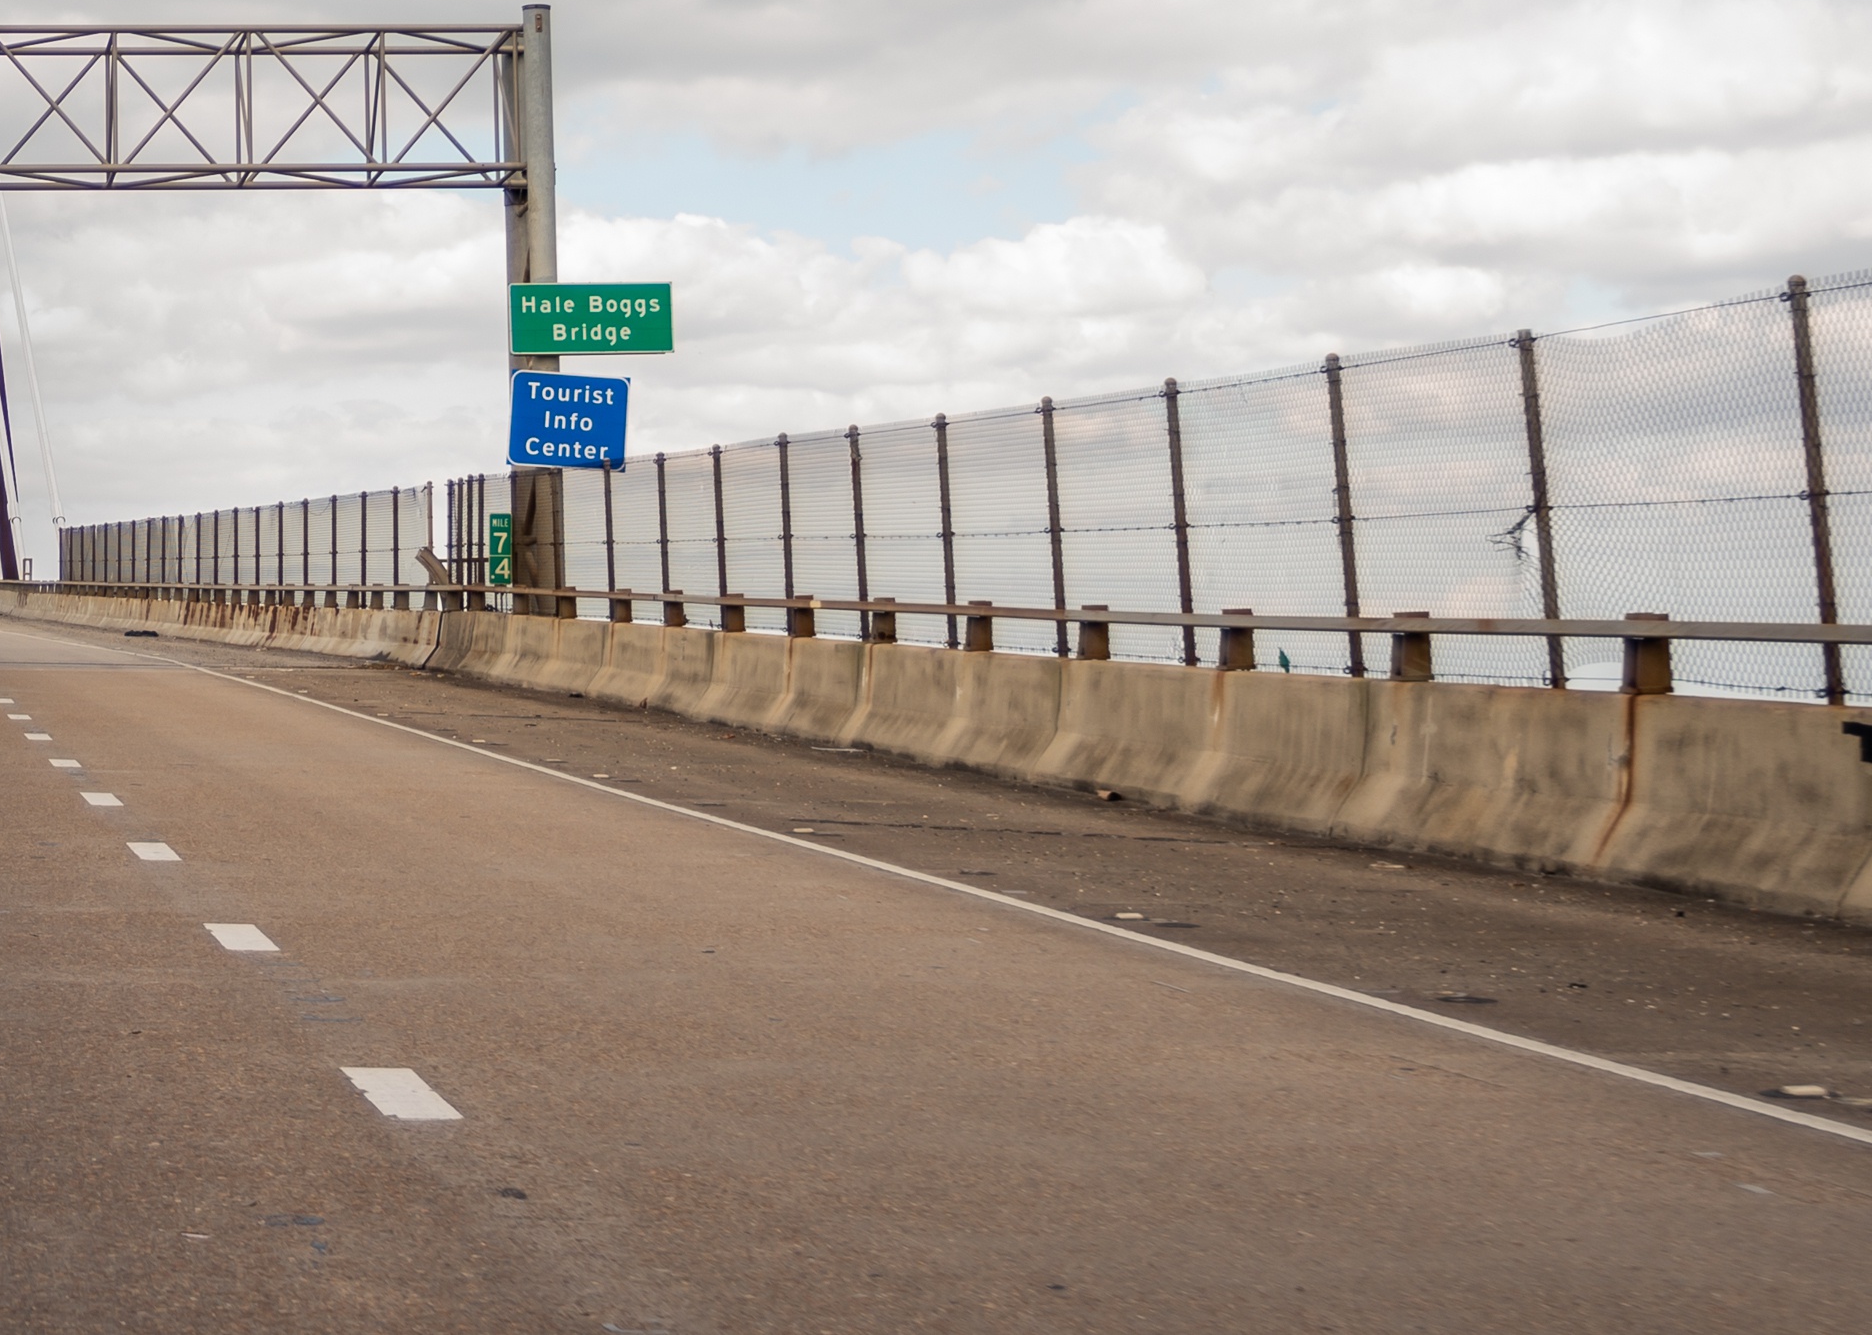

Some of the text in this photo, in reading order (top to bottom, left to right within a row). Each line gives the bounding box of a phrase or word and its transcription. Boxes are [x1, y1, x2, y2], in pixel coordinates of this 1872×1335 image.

[521, 295, 661, 318] Hale Boggs
[553, 323, 631, 346] Bridge
[528, 382, 614, 405] Tourist
[544, 410, 593, 431] Info
[525, 437, 608, 460] Center
[492, 518, 508, 527] MILE
[493, 532, 508, 553] 7
